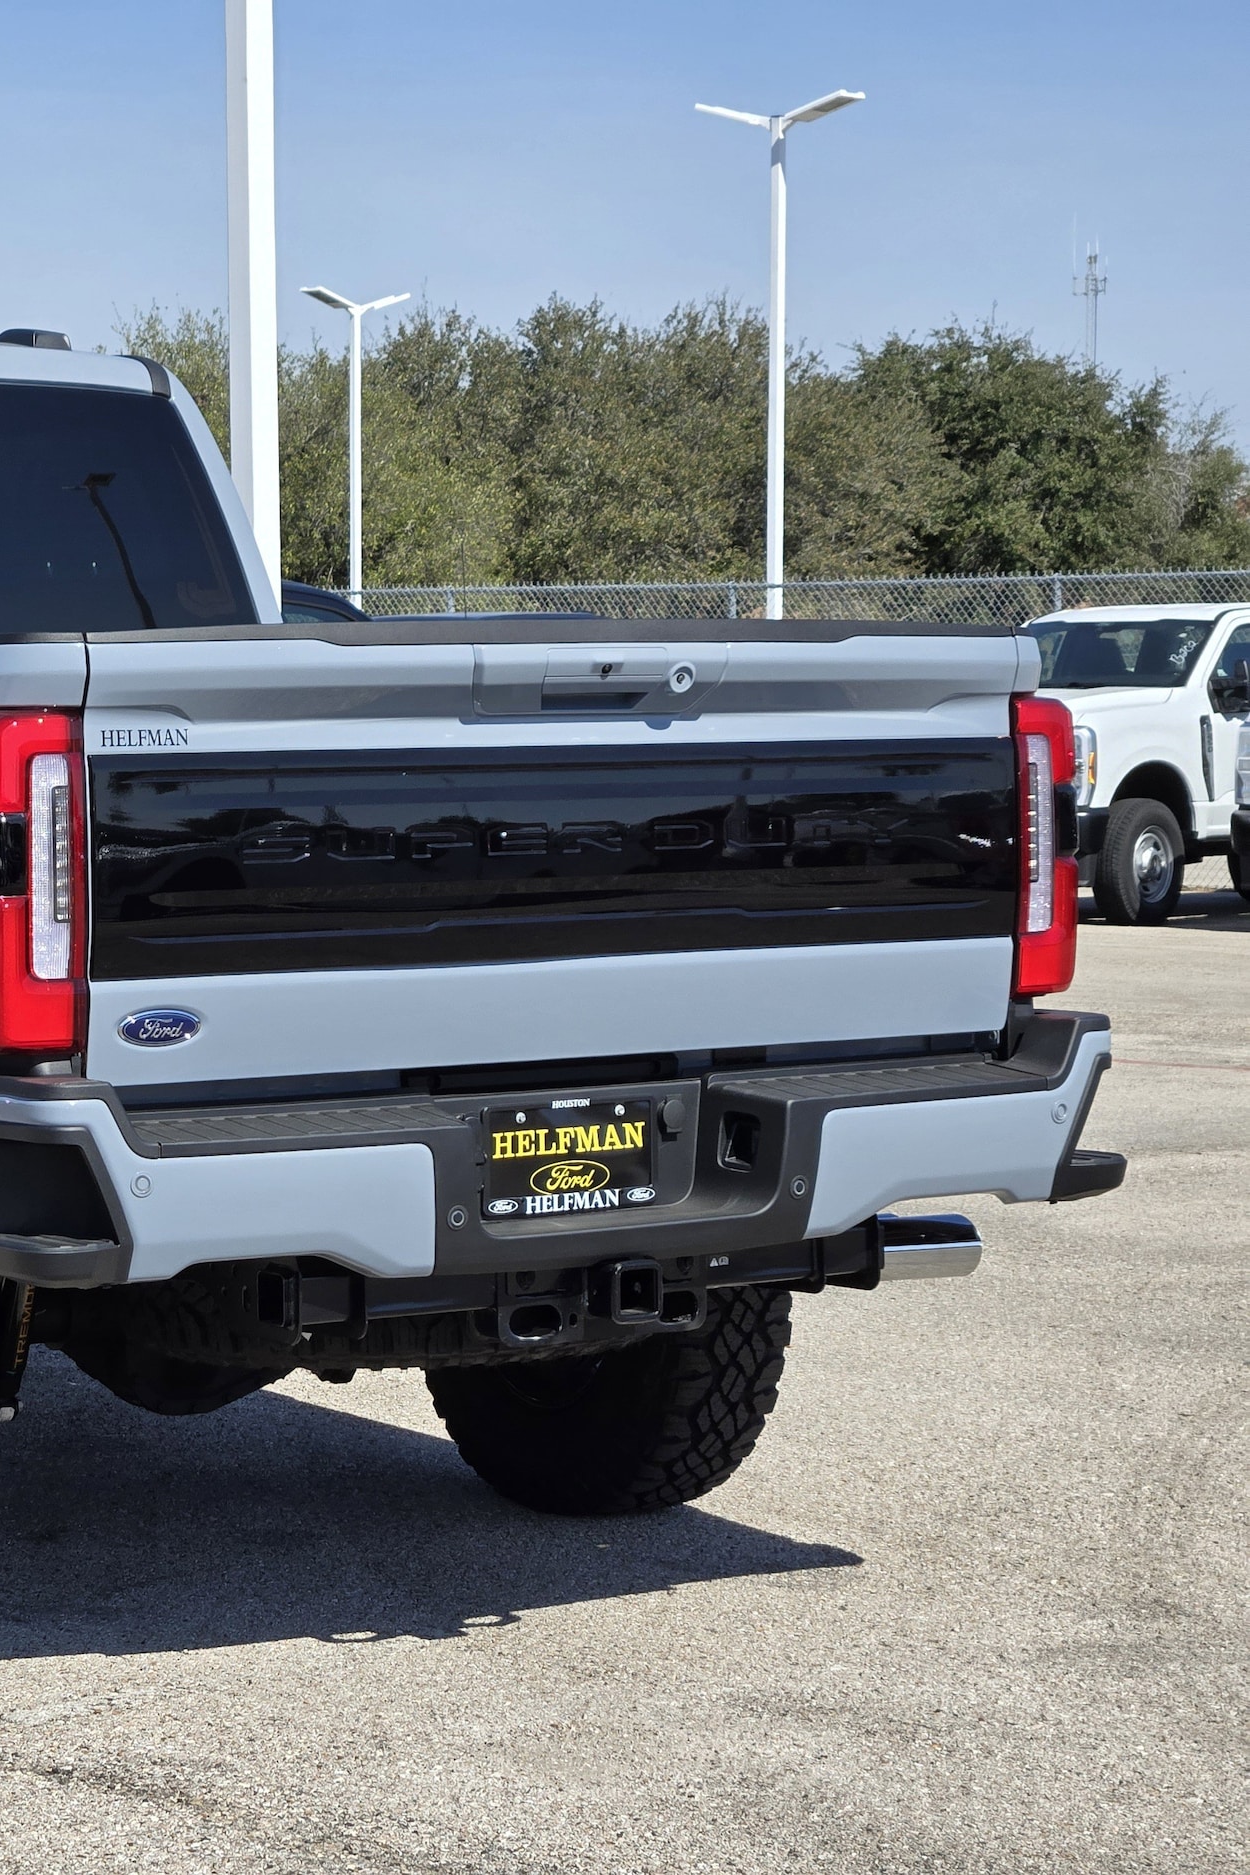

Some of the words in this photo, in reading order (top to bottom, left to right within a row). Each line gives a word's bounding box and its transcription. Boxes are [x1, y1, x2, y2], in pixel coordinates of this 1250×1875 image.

[100, 728, 188, 747] HELFMAN
[233, 820, 623, 865] SUPER
[139, 1018, 184, 1039] Ford
[551, 1098, 590, 1109] HOUSTON
[492, 1121, 645, 1159] HELFMAN
[546, 1164, 595, 1190] Ford
[525, 1188, 621, 1214] HELFMAN
